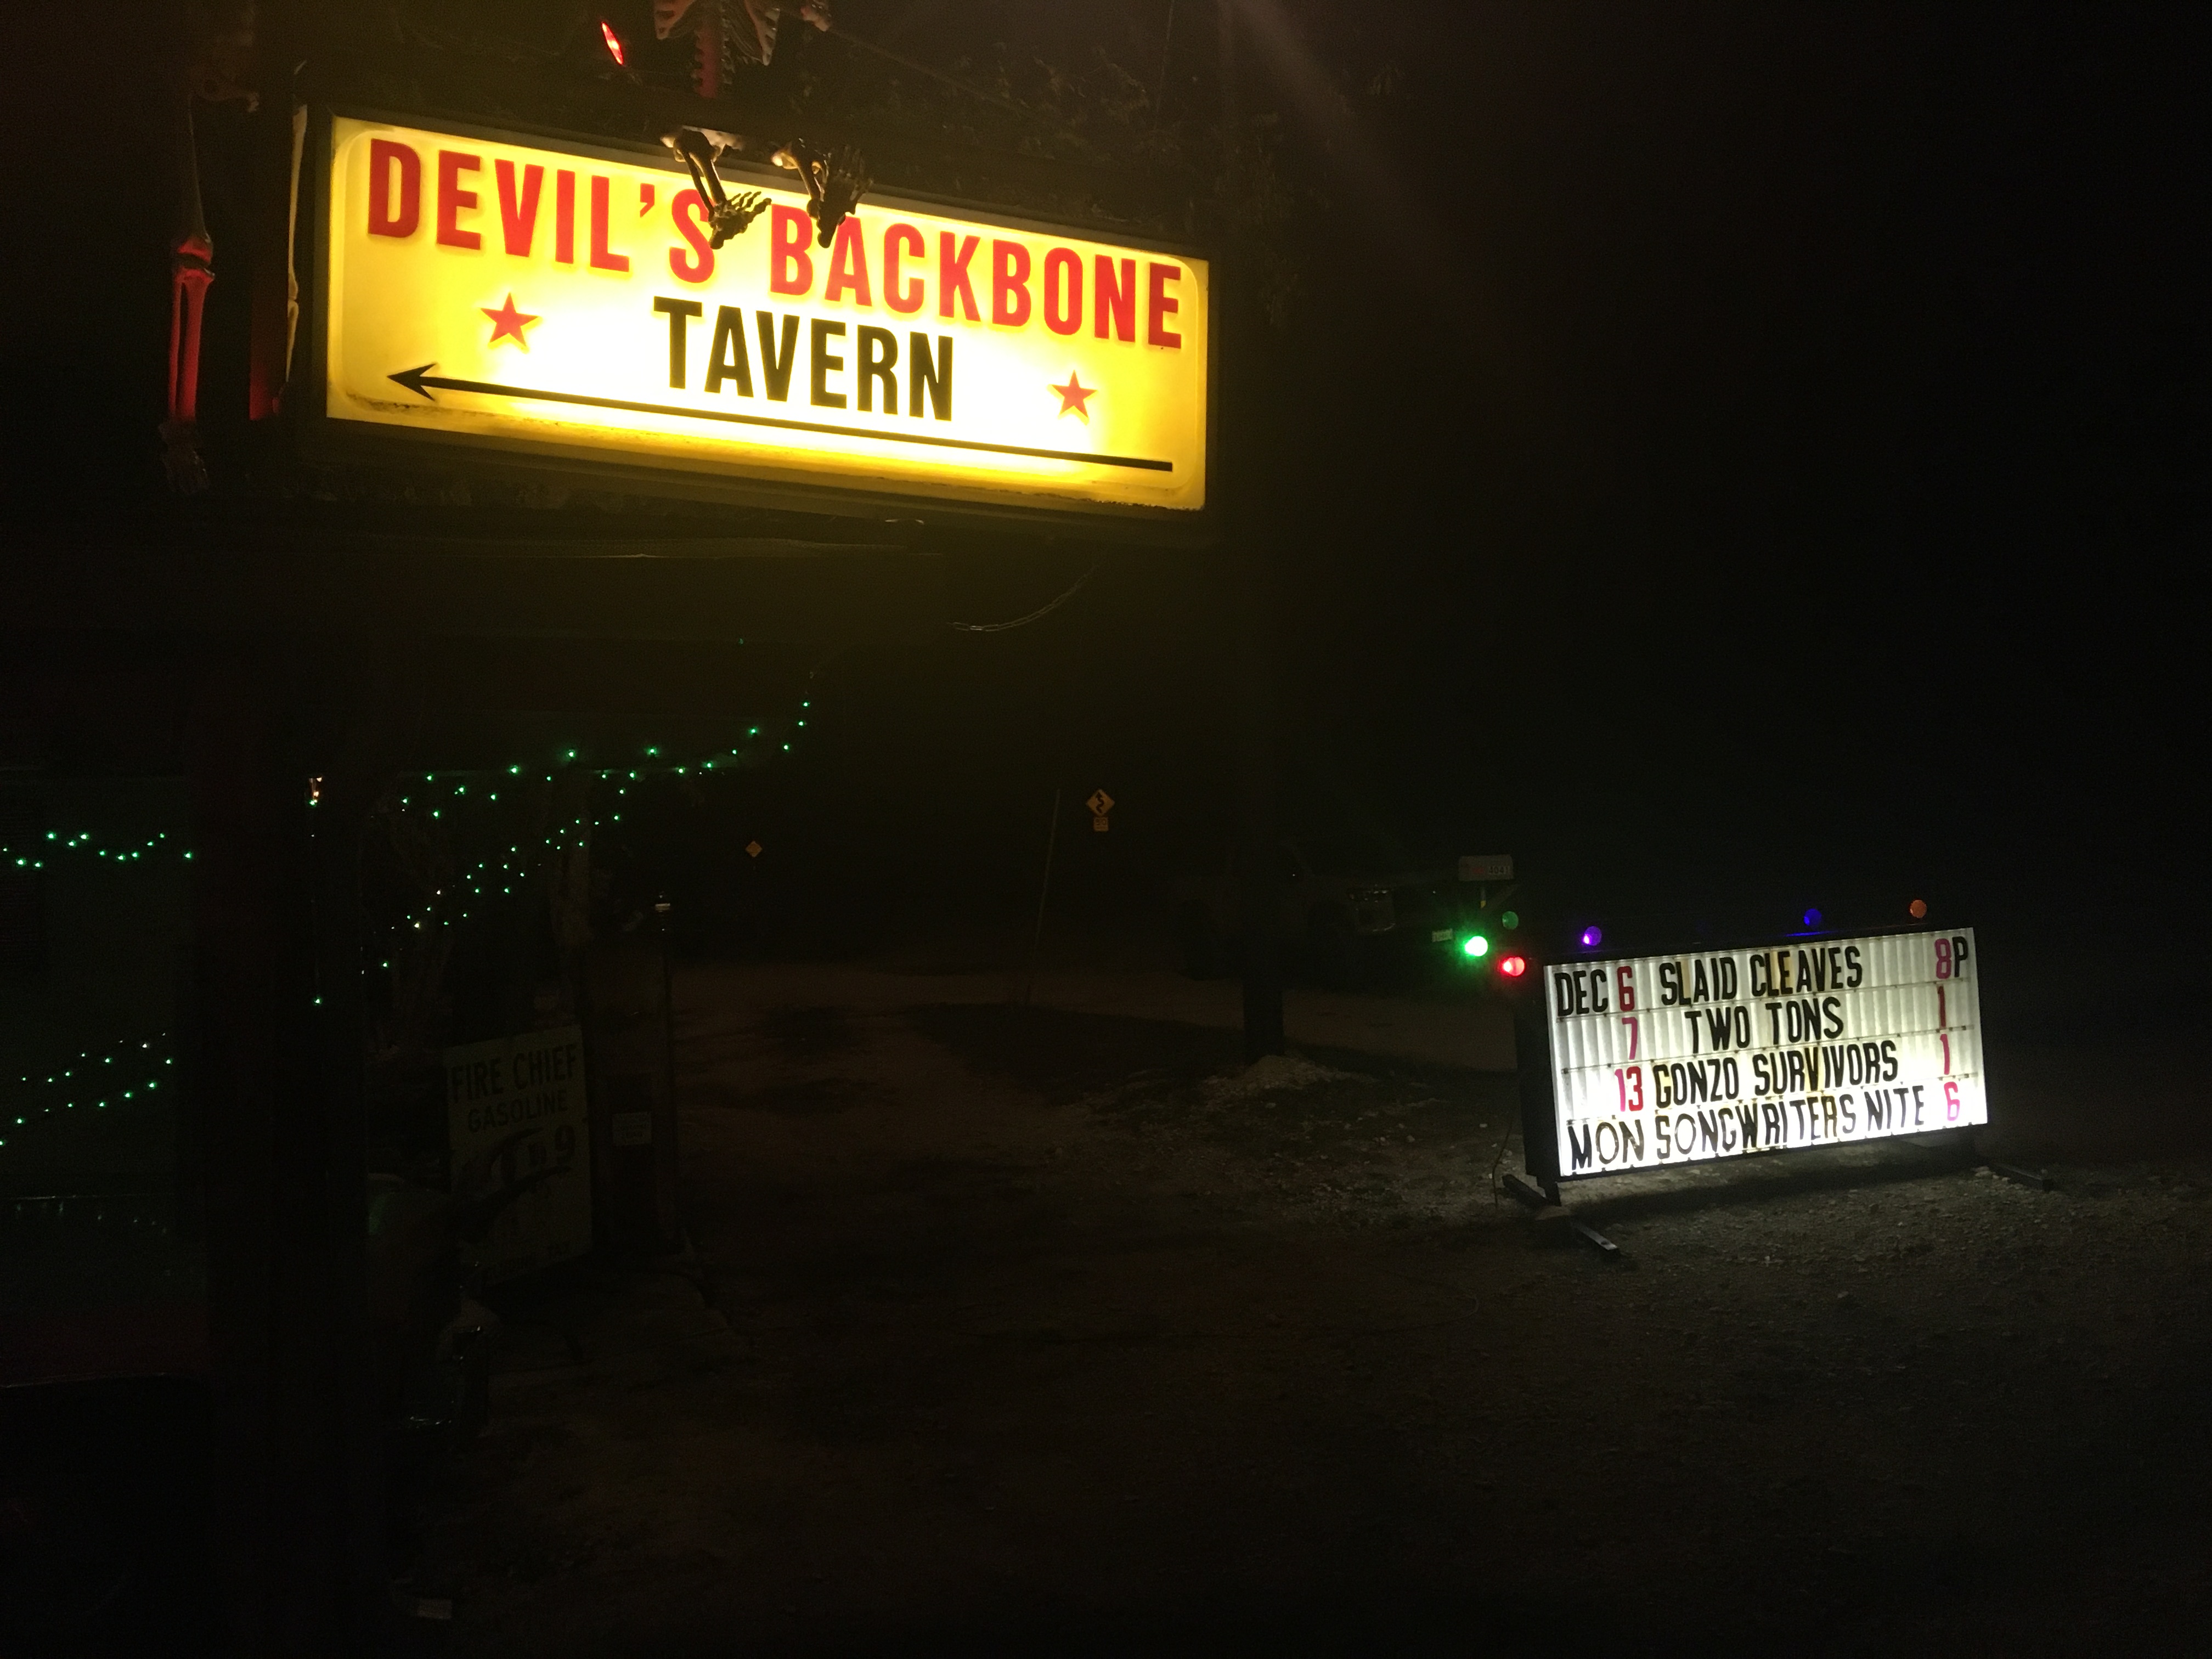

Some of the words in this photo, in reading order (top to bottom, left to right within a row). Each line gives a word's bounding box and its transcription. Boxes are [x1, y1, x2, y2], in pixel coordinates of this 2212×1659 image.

[367, 138, 715, 284] DEVIL'S
[770, 202, 1182, 349] BACKBONE
[653, 296, 953, 421] TAVERN
[1554, 968, 1608, 1017] DEC
[1617, 966, 1635, 1012] 6
[1659, 956, 1737, 1006] SLAID
[1750, 946, 1863, 997] CLEAVES
[1622, 1017, 1638, 1060] 7
[1685, 1006, 1751, 1054] TWO
[1765, 996, 1844, 1045] TONS
[1937, 984, 1947, 1028] 1
[451, 1057, 504, 1104] FIRE
[512, 1043, 577, 1090] CHIEF
[467, 1089, 568, 1133] GASOLINE
[1614, 1066, 1643, 1112] 13
[1652, 1057, 1739, 1109] GONZO
[1752, 1040, 1898, 1096] SURVIVORS
[1939, 1034, 1950, 1075] 1
[1567, 1119, 1644, 1171] MON
[1865, 1085, 1925, 1132] NITE
[1944, 1081, 1961, 1121] 6
